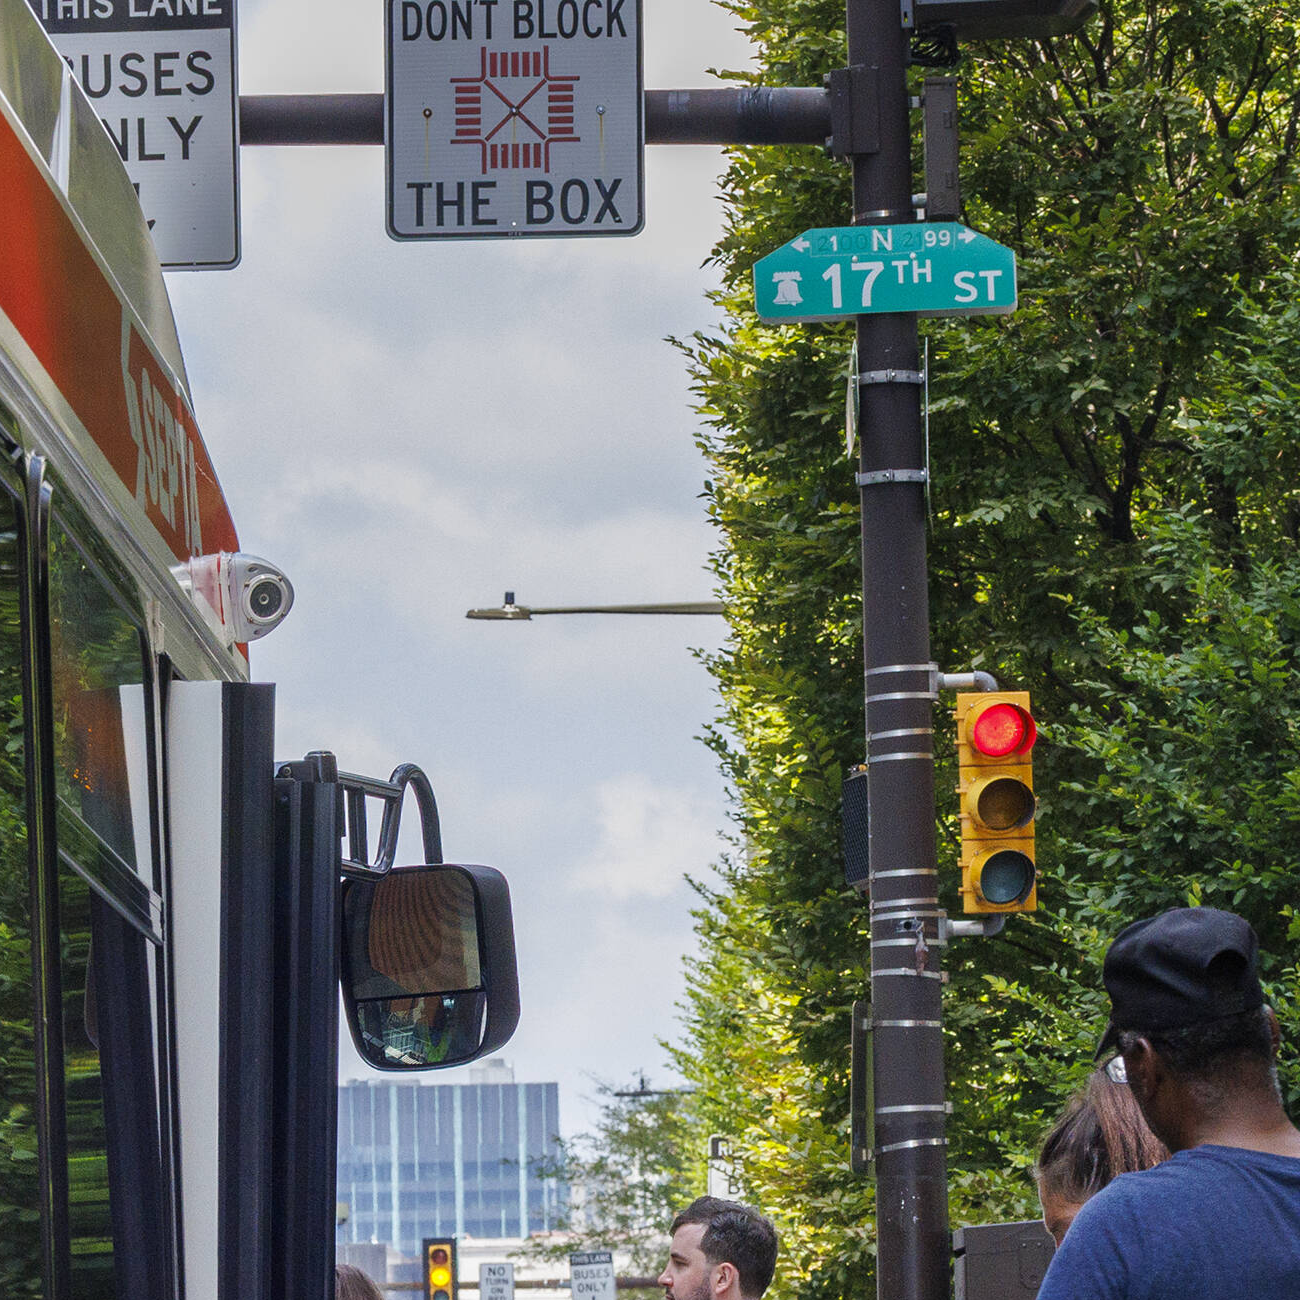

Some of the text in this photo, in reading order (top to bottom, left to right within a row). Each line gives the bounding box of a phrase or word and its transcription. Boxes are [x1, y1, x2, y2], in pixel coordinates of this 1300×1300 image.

[402, 0, 627, 41] DON'T BLOCK
[62, 51, 215, 98] USES
[101, 115, 204, 161] NLY
[406, 178, 623, 226] THE BOX
[872, 228, 893, 251] N
[821, 259, 1003, 308] 17TH ST
[141, 367, 203, 557] SEPTA
[488, 1266, 505, 1276] NO
[573, 1268, 610, 1279] BUSES
[577, 1281, 607, 1293] ONLY
